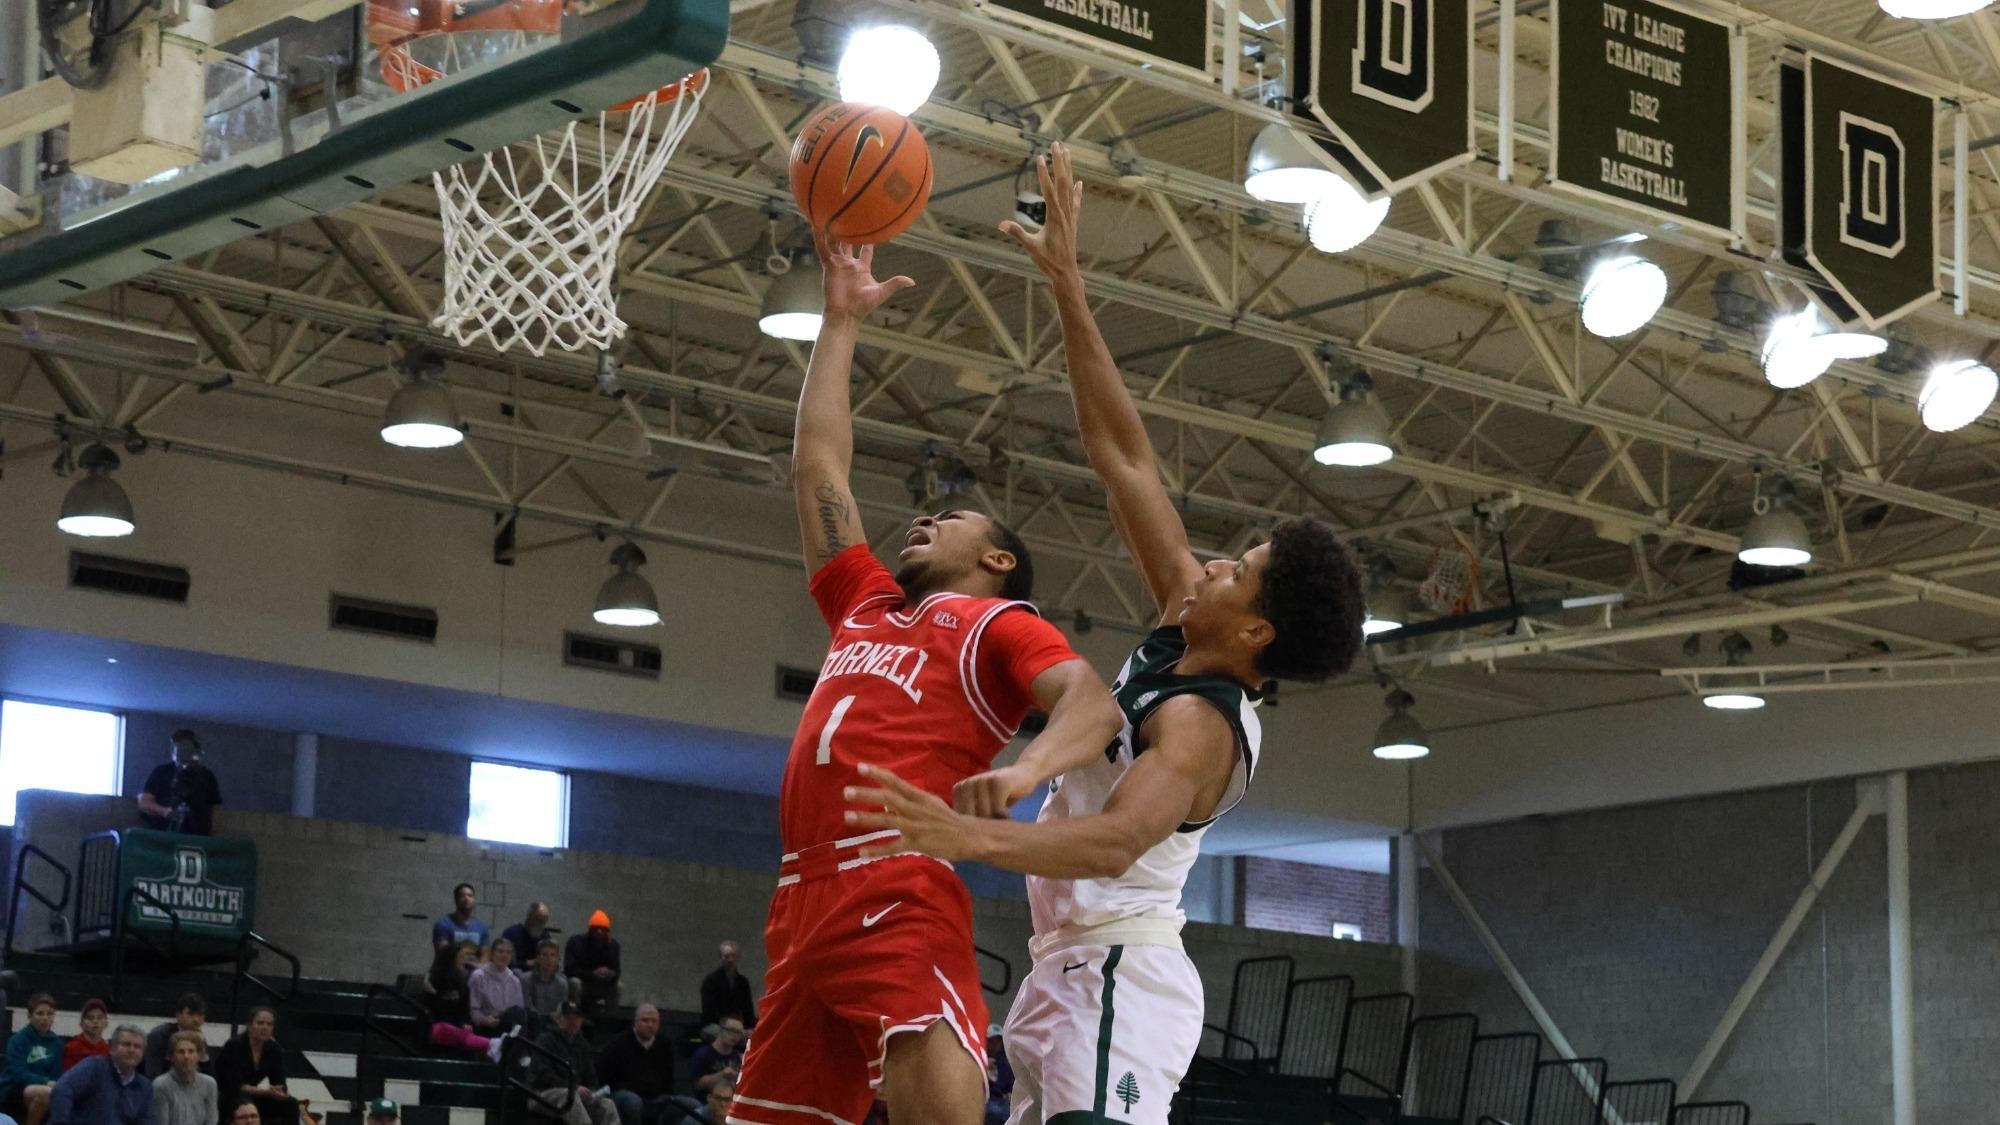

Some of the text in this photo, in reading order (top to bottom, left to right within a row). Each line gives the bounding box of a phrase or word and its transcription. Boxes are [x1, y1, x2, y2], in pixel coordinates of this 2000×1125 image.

[1603, 2, 1686, 53] IVY LEAGUE
[1352, 0, 1434, 114] D
[1605, 39, 1682, 87] CHAMPIONS
[1629, 90, 1660, 124] 1982
[1616, 127, 1674, 168] WOMEN'S
[1601, 157, 1688, 206] BASKETBALL
[1839, 110, 1905, 259] D
[816, 695, 856, 765] 1
[177, 849, 203, 885] D
[137, 882, 241, 911] DARTMOUTH
